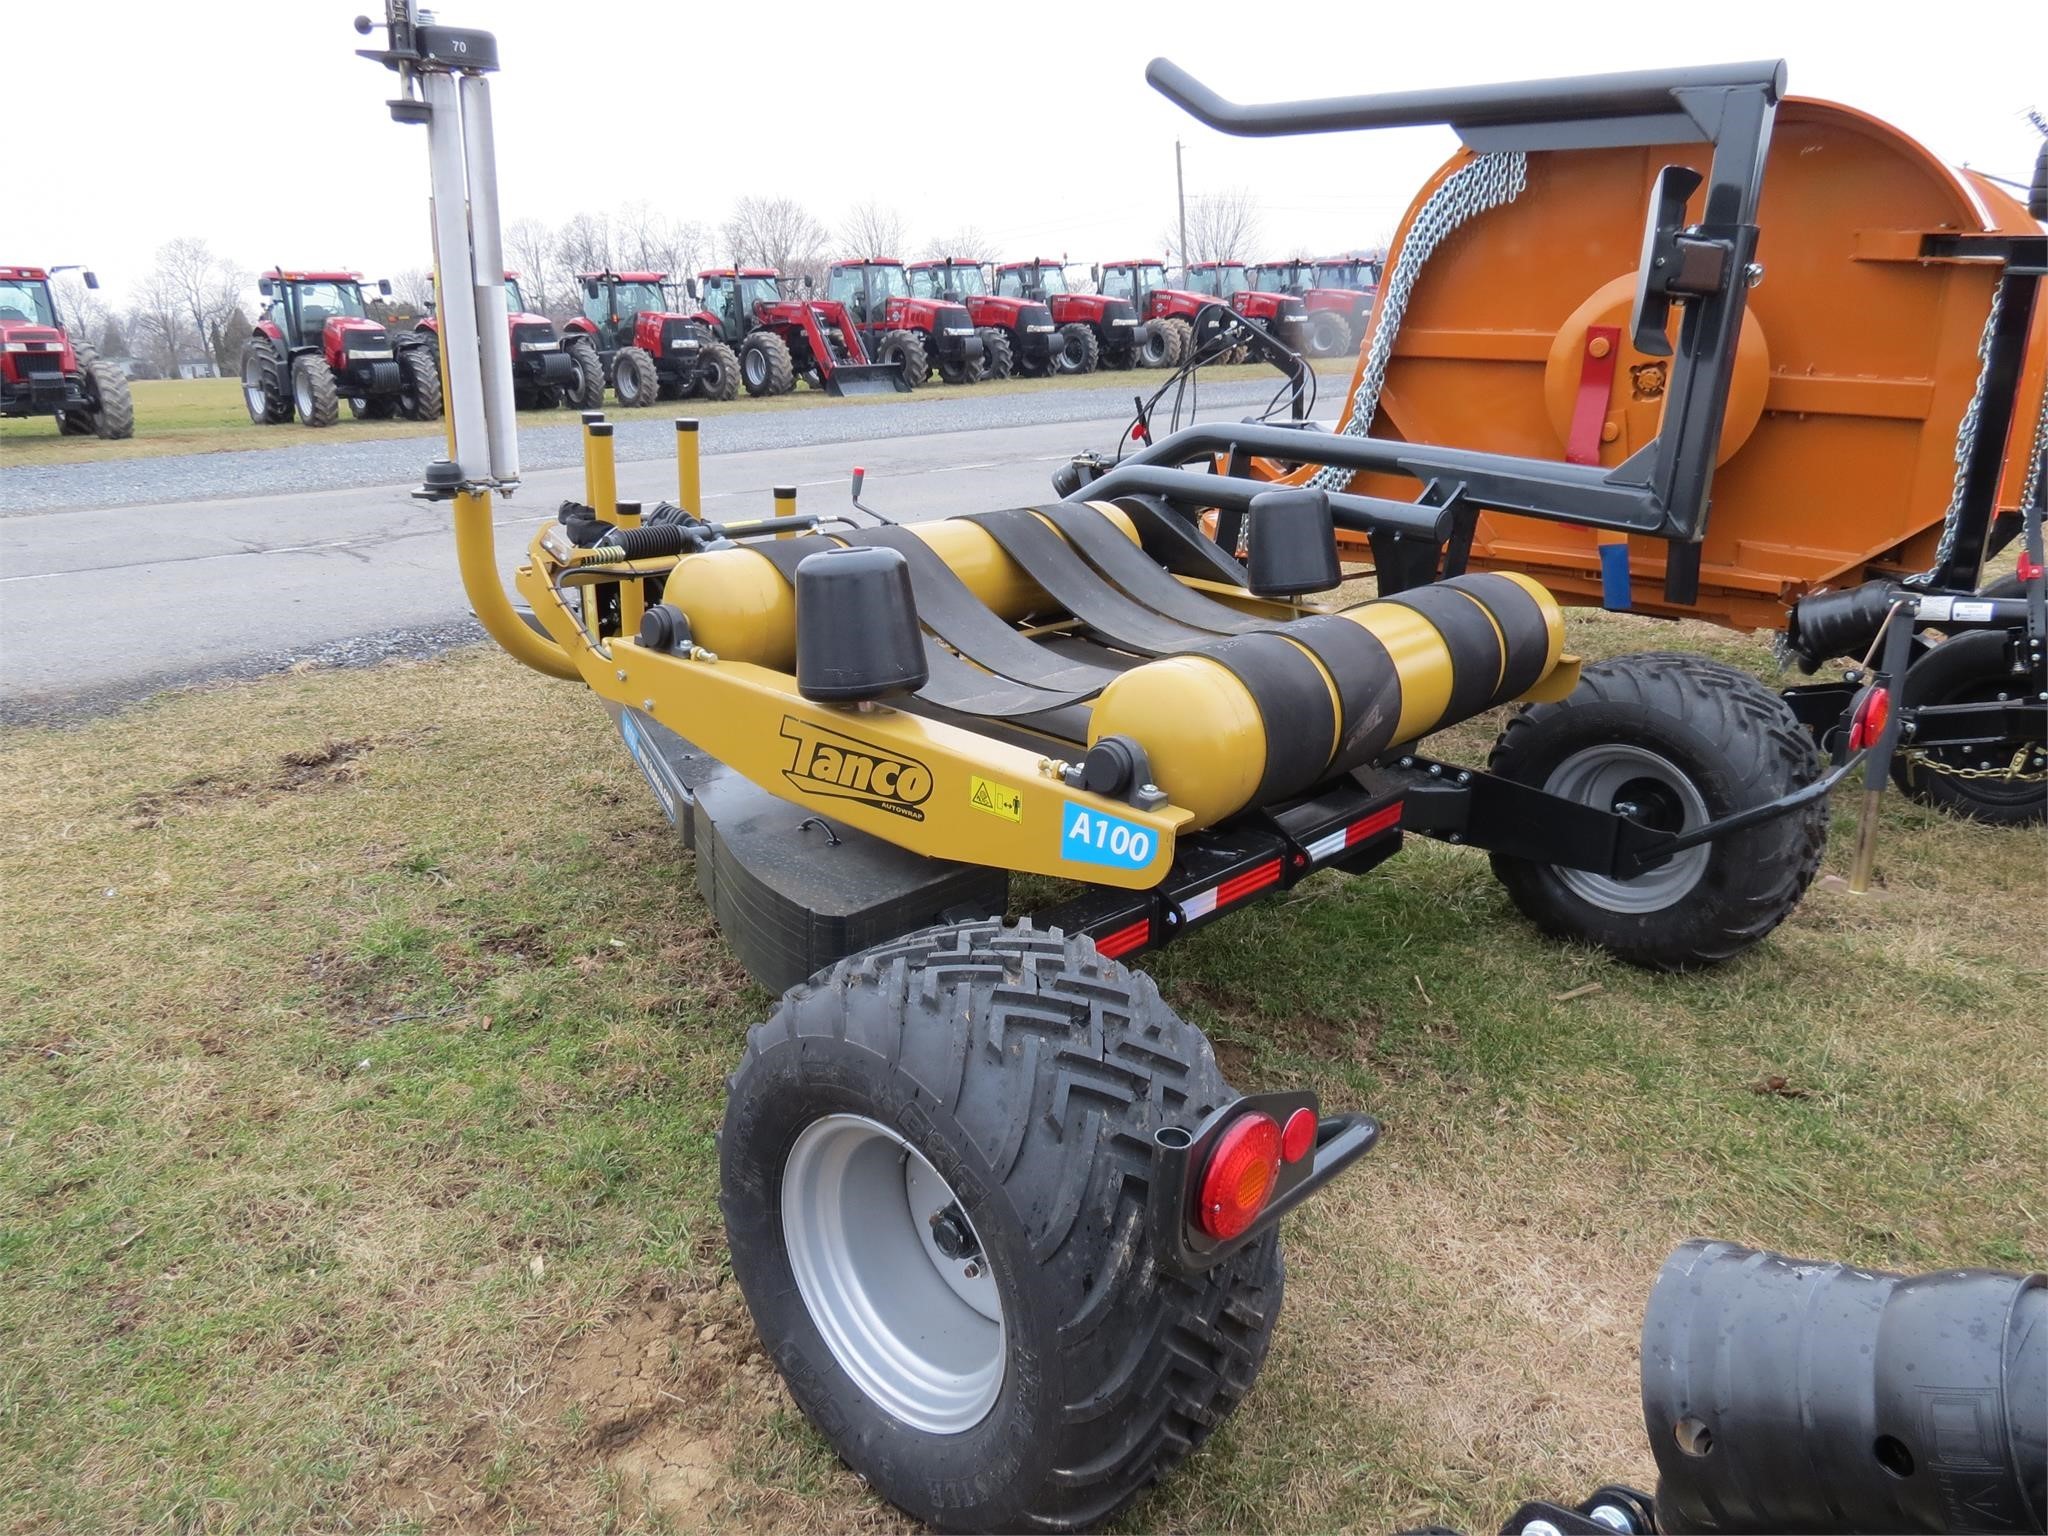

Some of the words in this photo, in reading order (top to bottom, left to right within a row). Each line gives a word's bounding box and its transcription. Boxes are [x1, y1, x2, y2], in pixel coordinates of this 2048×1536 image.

[452, 41, 467, 53] 70
[779, 714, 934, 806] Tanco
[881, 802, 923, 819] AUTOWRAP
[1068, 811, 1150, 863] A100
